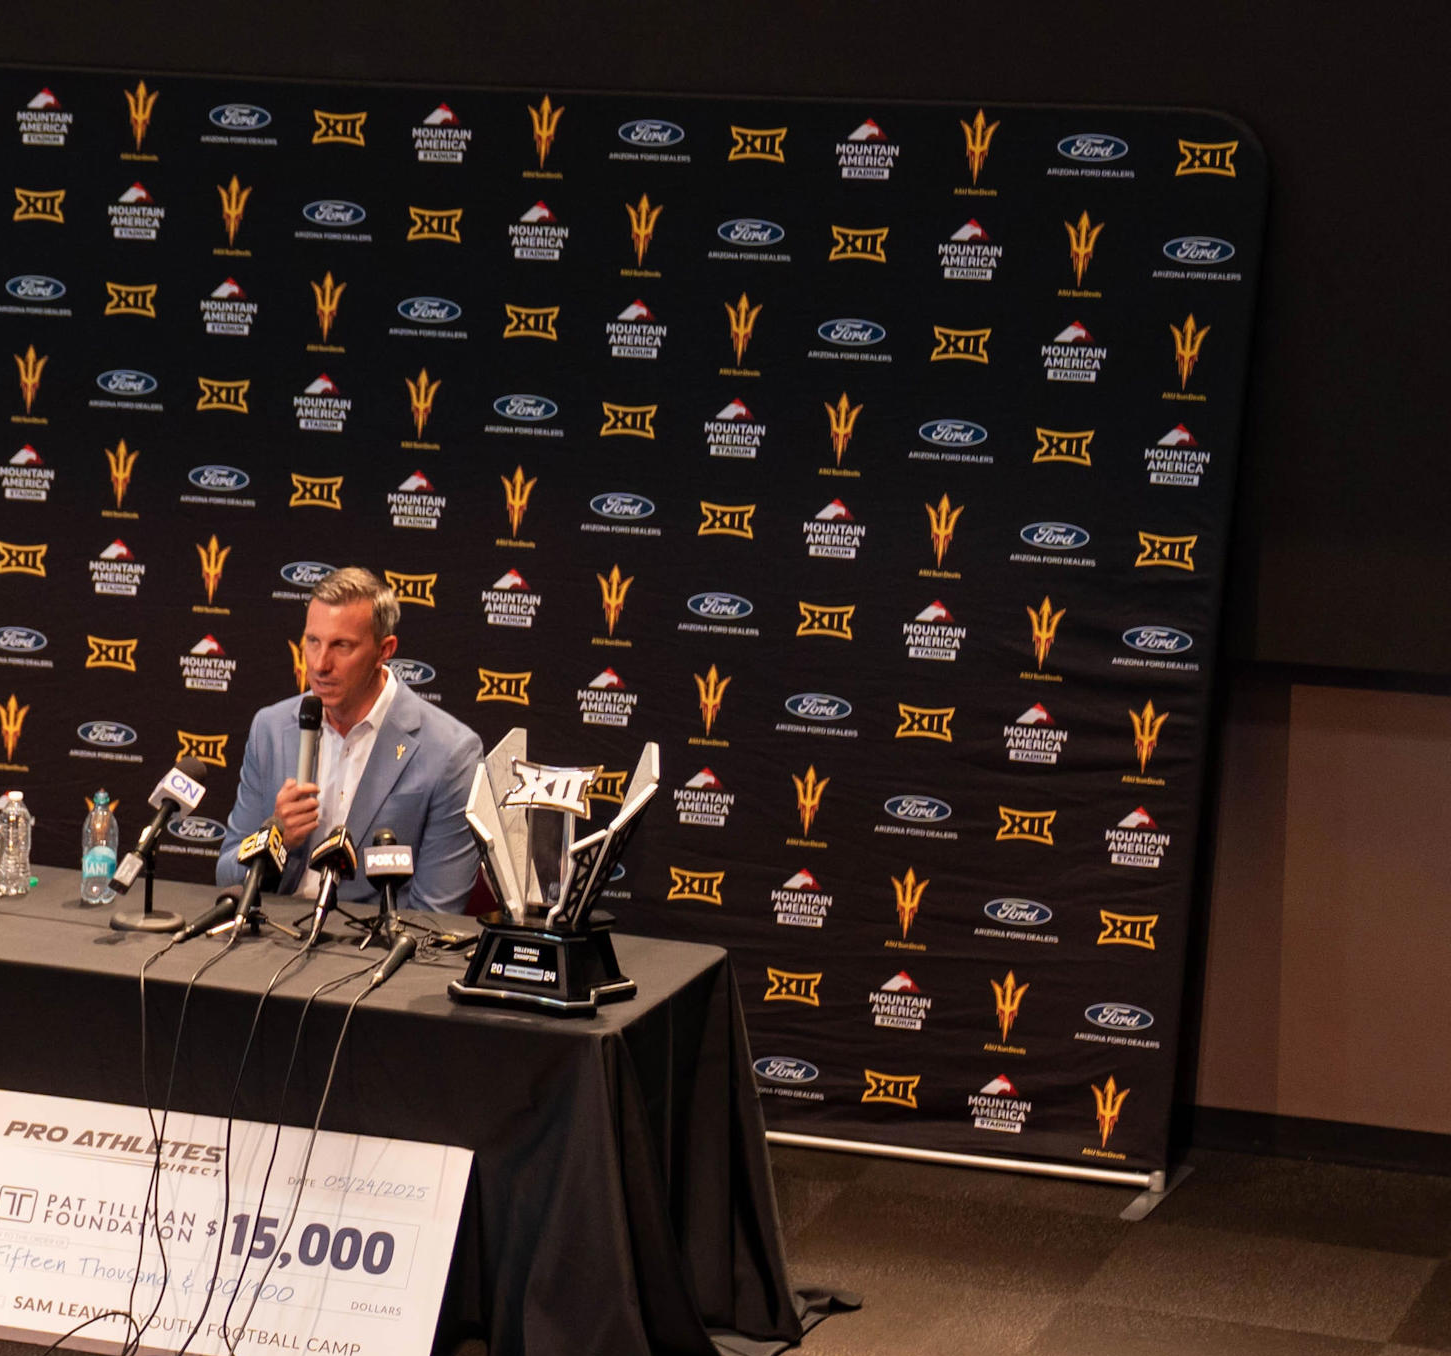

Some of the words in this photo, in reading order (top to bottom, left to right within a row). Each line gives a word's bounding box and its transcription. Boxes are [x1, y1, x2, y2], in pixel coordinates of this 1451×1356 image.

[17, 110, 72, 124] MOUNTAIN
[218, 106, 259, 127] Ford
[19, 122, 68, 134] AMERICA
[412, 127, 471, 141] MOUNTAIN
[629, 122, 672, 143] Ford
[414, 139, 467, 150] AMERICA
[836, 142, 899, 157] MOUNTAIN
[1069, 136, 1115, 159] Ford
[839, 155, 894, 167] AMERICA
[312, 202, 353, 223] Ford
[728, 222, 771, 243] Ford
[938, 243, 1002, 258] MOUNTAIN
[1174, 239, 1221, 261] Ford
[941, 255, 997, 268] AMERICA
[15, 277, 54, 298] Ford
[606, 322, 666, 337] MOUNTAIN
[828, 321, 873, 343] Ford
[608, 334, 661, 347] AMERICA
[1042, 344, 1106, 360] MOUNTAIN
[1045, 357, 1101, 370] AMERICA
[503, 396, 545, 418] Ford
[929, 422, 974, 444] Ford
[1145, 448, 1210, 463] MOUNTAIN
[1148, 460, 1205, 474] AMERICA
[600, 495, 643, 517] Ford
[803, 522, 865, 537] MOUNTAIN
[1031, 525, 1077, 547] Ford
[805, 534, 860, 547] AMERICA
[697, 594, 740, 617] Ford
[903, 623, 966, 639] MOUNTAIN
[1133, 628, 1179, 651] Ford
[906, 635, 961, 649] AMERICA
[179, 656, 236, 671] MOUNTAIN
[181, 667, 232, 681] AMERICA
[795, 696, 839, 718] Ford
[1004, 725, 1067, 742] MOUNTAIN
[1007, 738, 1062, 752] AMERICA
[171, 775, 199, 800] CN
[894, 797, 938, 820] Ford
[257, 829, 270, 847] 15
[1105, 829, 1170, 846] MOUNTAIN
[279, 844, 288, 865] 15
[1108, 841, 1165, 857] AMERICA
[367, 854, 393, 867] FOX
[395, 853, 411, 866] 10
[994, 900, 1039, 923] Ford
[490, 963, 503, 975] 20
[544, 970, 556, 983] 24
[869, 992, 931, 1009] MOUNTAIN
[871, 1004, 926, 1019] AMERICA
[1095, 1005, 1141, 1028] Ford
[968, 1095, 1031, 1112] MOUNTAIN
[971, 1107, 1026, 1122] AMERICA
[3, 1120, 69, 1143] PRO
[72, 1130, 228, 1164] ATHLETES
[159, 1162, 222, 1178] DIRECT
[287, 1176, 316, 1188] DATE
[323, 1175, 430, 1199] 05/24/2025
[47, 1194, 86, 1211] PAT
[98, 1200, 196, 1227] TILLMAN
[43, 1209, 193, 1243] FOUNDATION
[206, 1219, 218, 1237] $
[230, 1213, 395, 1275] 15,000
[79, 1257, 171, 1287] Thousand
[205, 1276, 294, 1303] 00/100
[351, 1301, 402, 1316] DOLLARS
[13, 1295, 53, 1314] SAM
[137, 1313, 201, 1336] YOUTH
[206, 1323, 300, 1349] FOOTBALL
